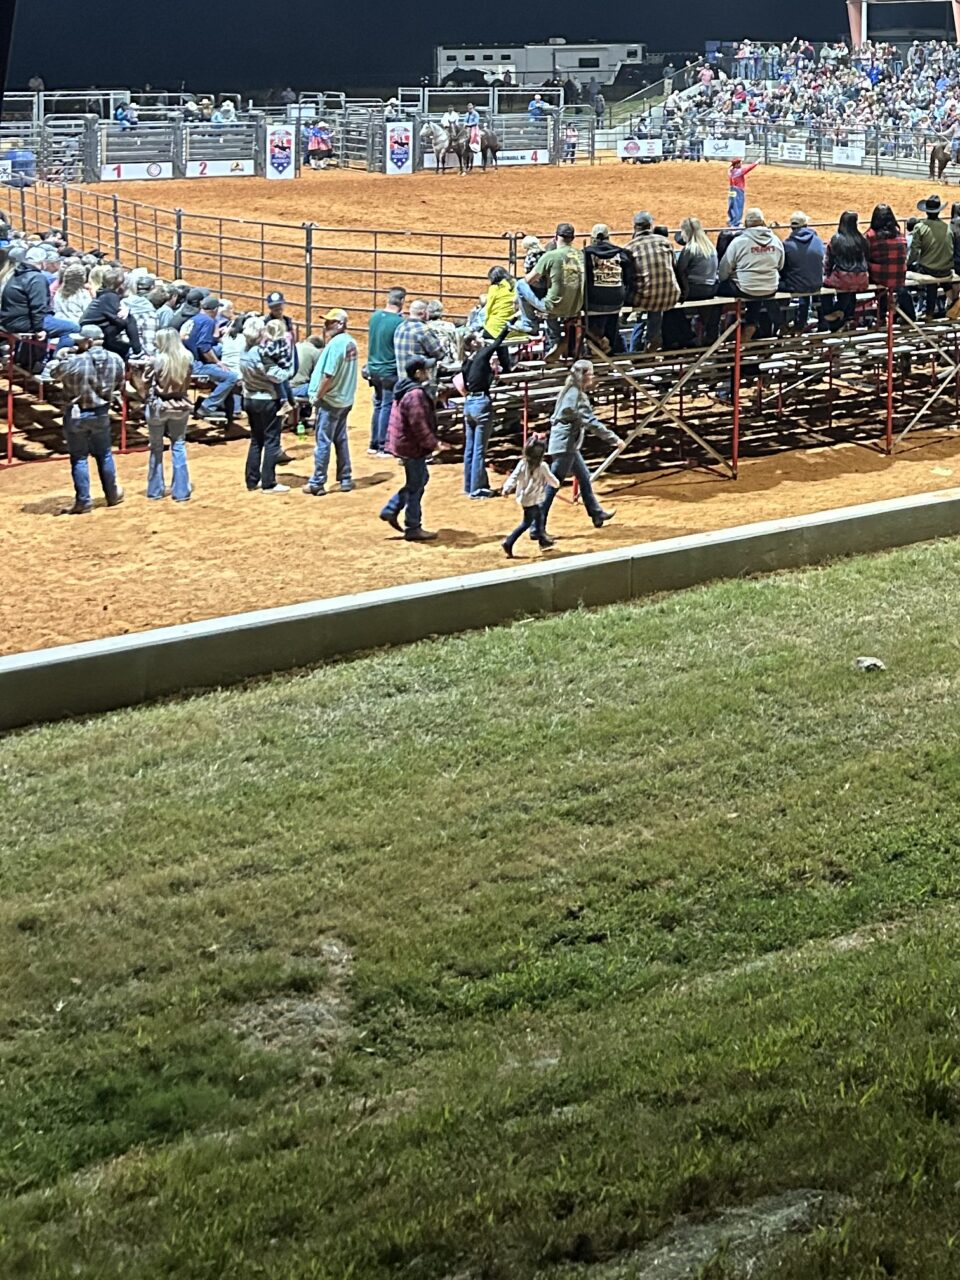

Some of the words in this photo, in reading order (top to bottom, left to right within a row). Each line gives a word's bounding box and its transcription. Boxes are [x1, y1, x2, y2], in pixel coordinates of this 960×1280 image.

[531, 150, 538, 162] 4
[112, 164, 121, 178] 1
[199, 162, 207, 175] 2
